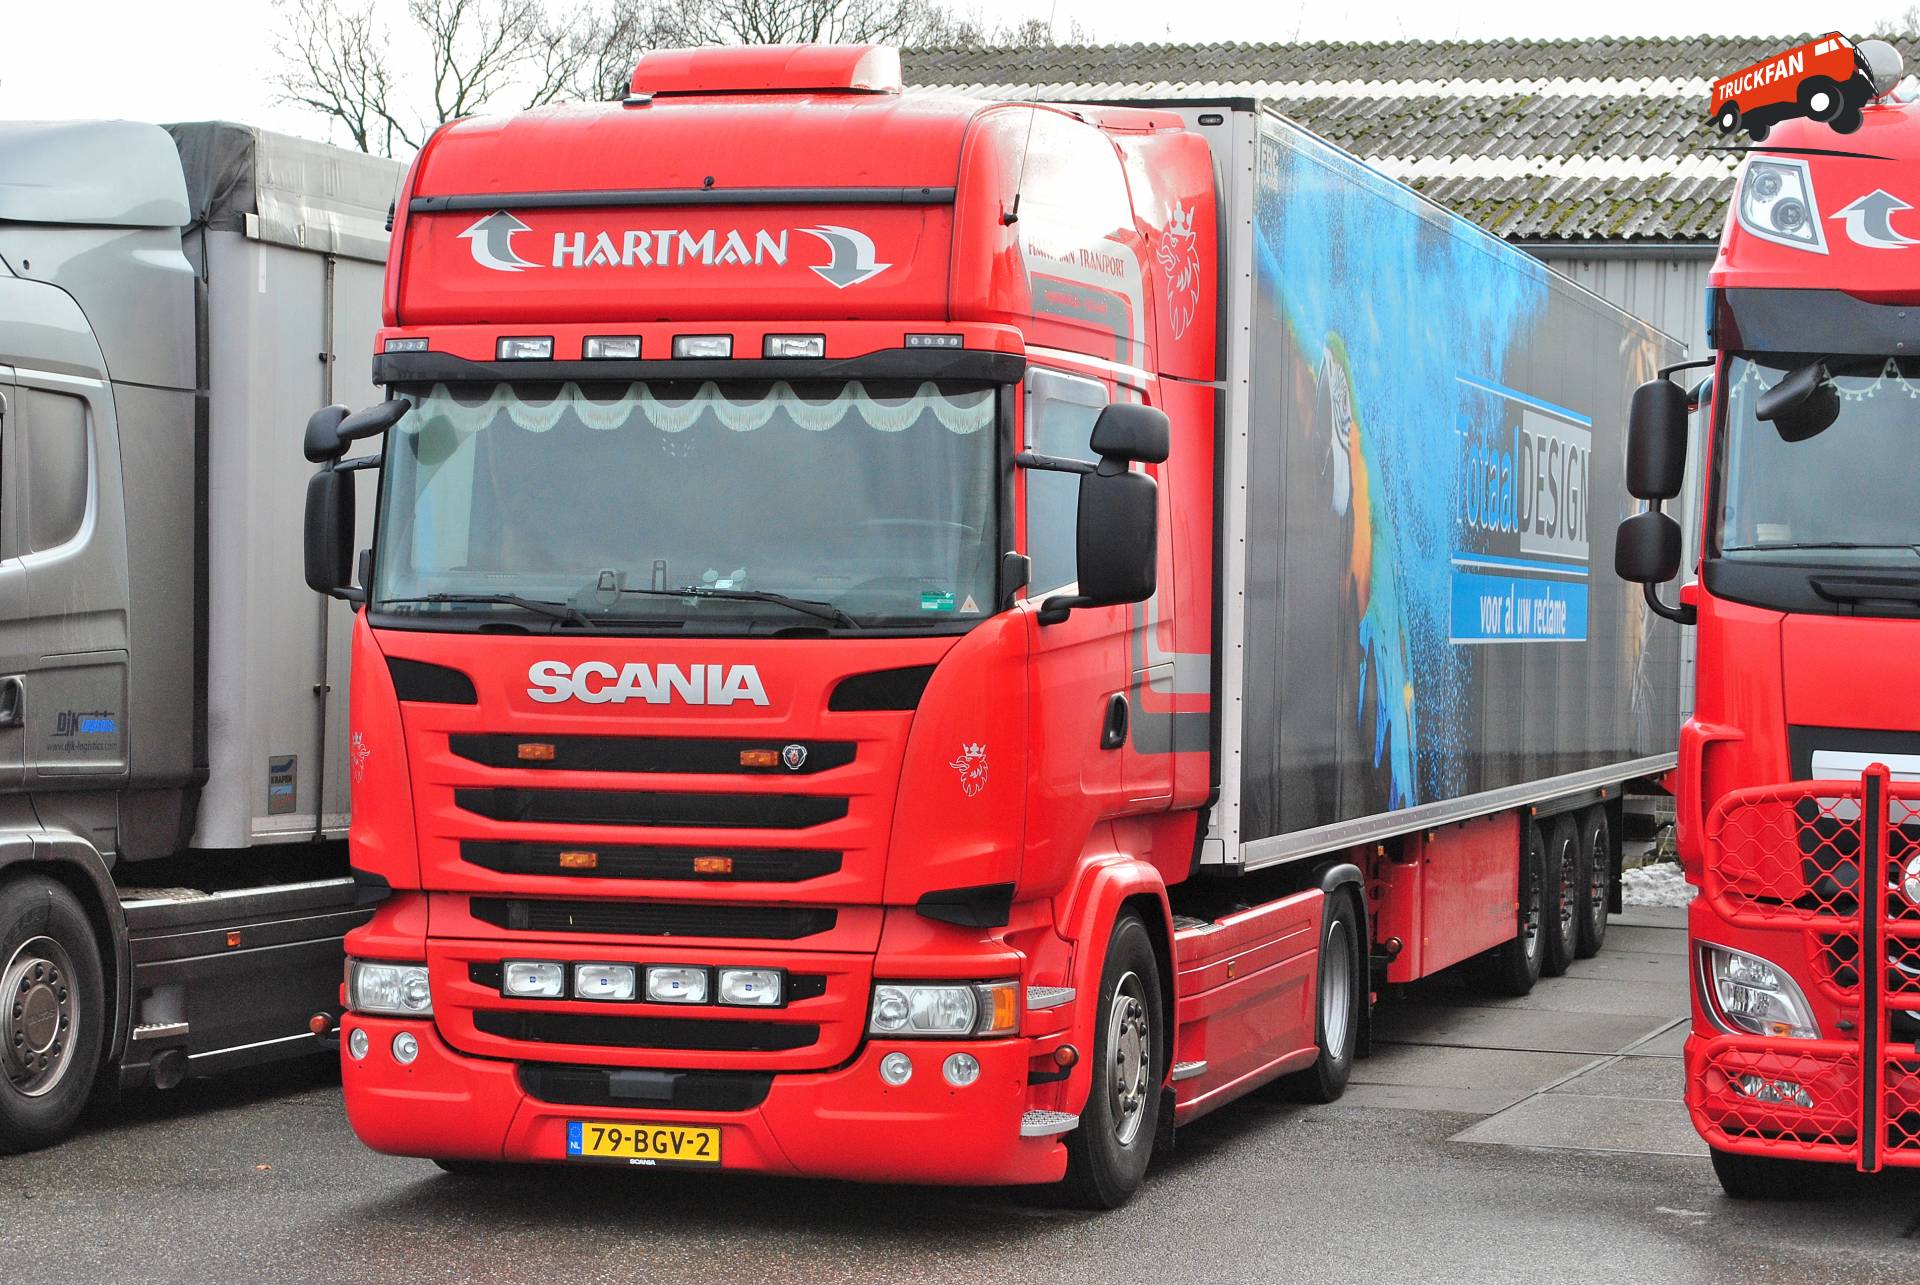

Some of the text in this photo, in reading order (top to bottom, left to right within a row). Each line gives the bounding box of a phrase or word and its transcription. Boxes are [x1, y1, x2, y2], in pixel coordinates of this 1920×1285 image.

[551, 228, 788, 269] HARTMAN
[1079, 248, 1125, 278] TRANSPORT
[1520, 428, 1590, 543] DESIGN
[1480, 583, 1567, 636] voor al uw reclame
[526, 660, 771, 706] SCANIA
[570, 1127, 711, 1157] NL 79-BGV-2
[629, 1158, 657, 1166] SCANIA
